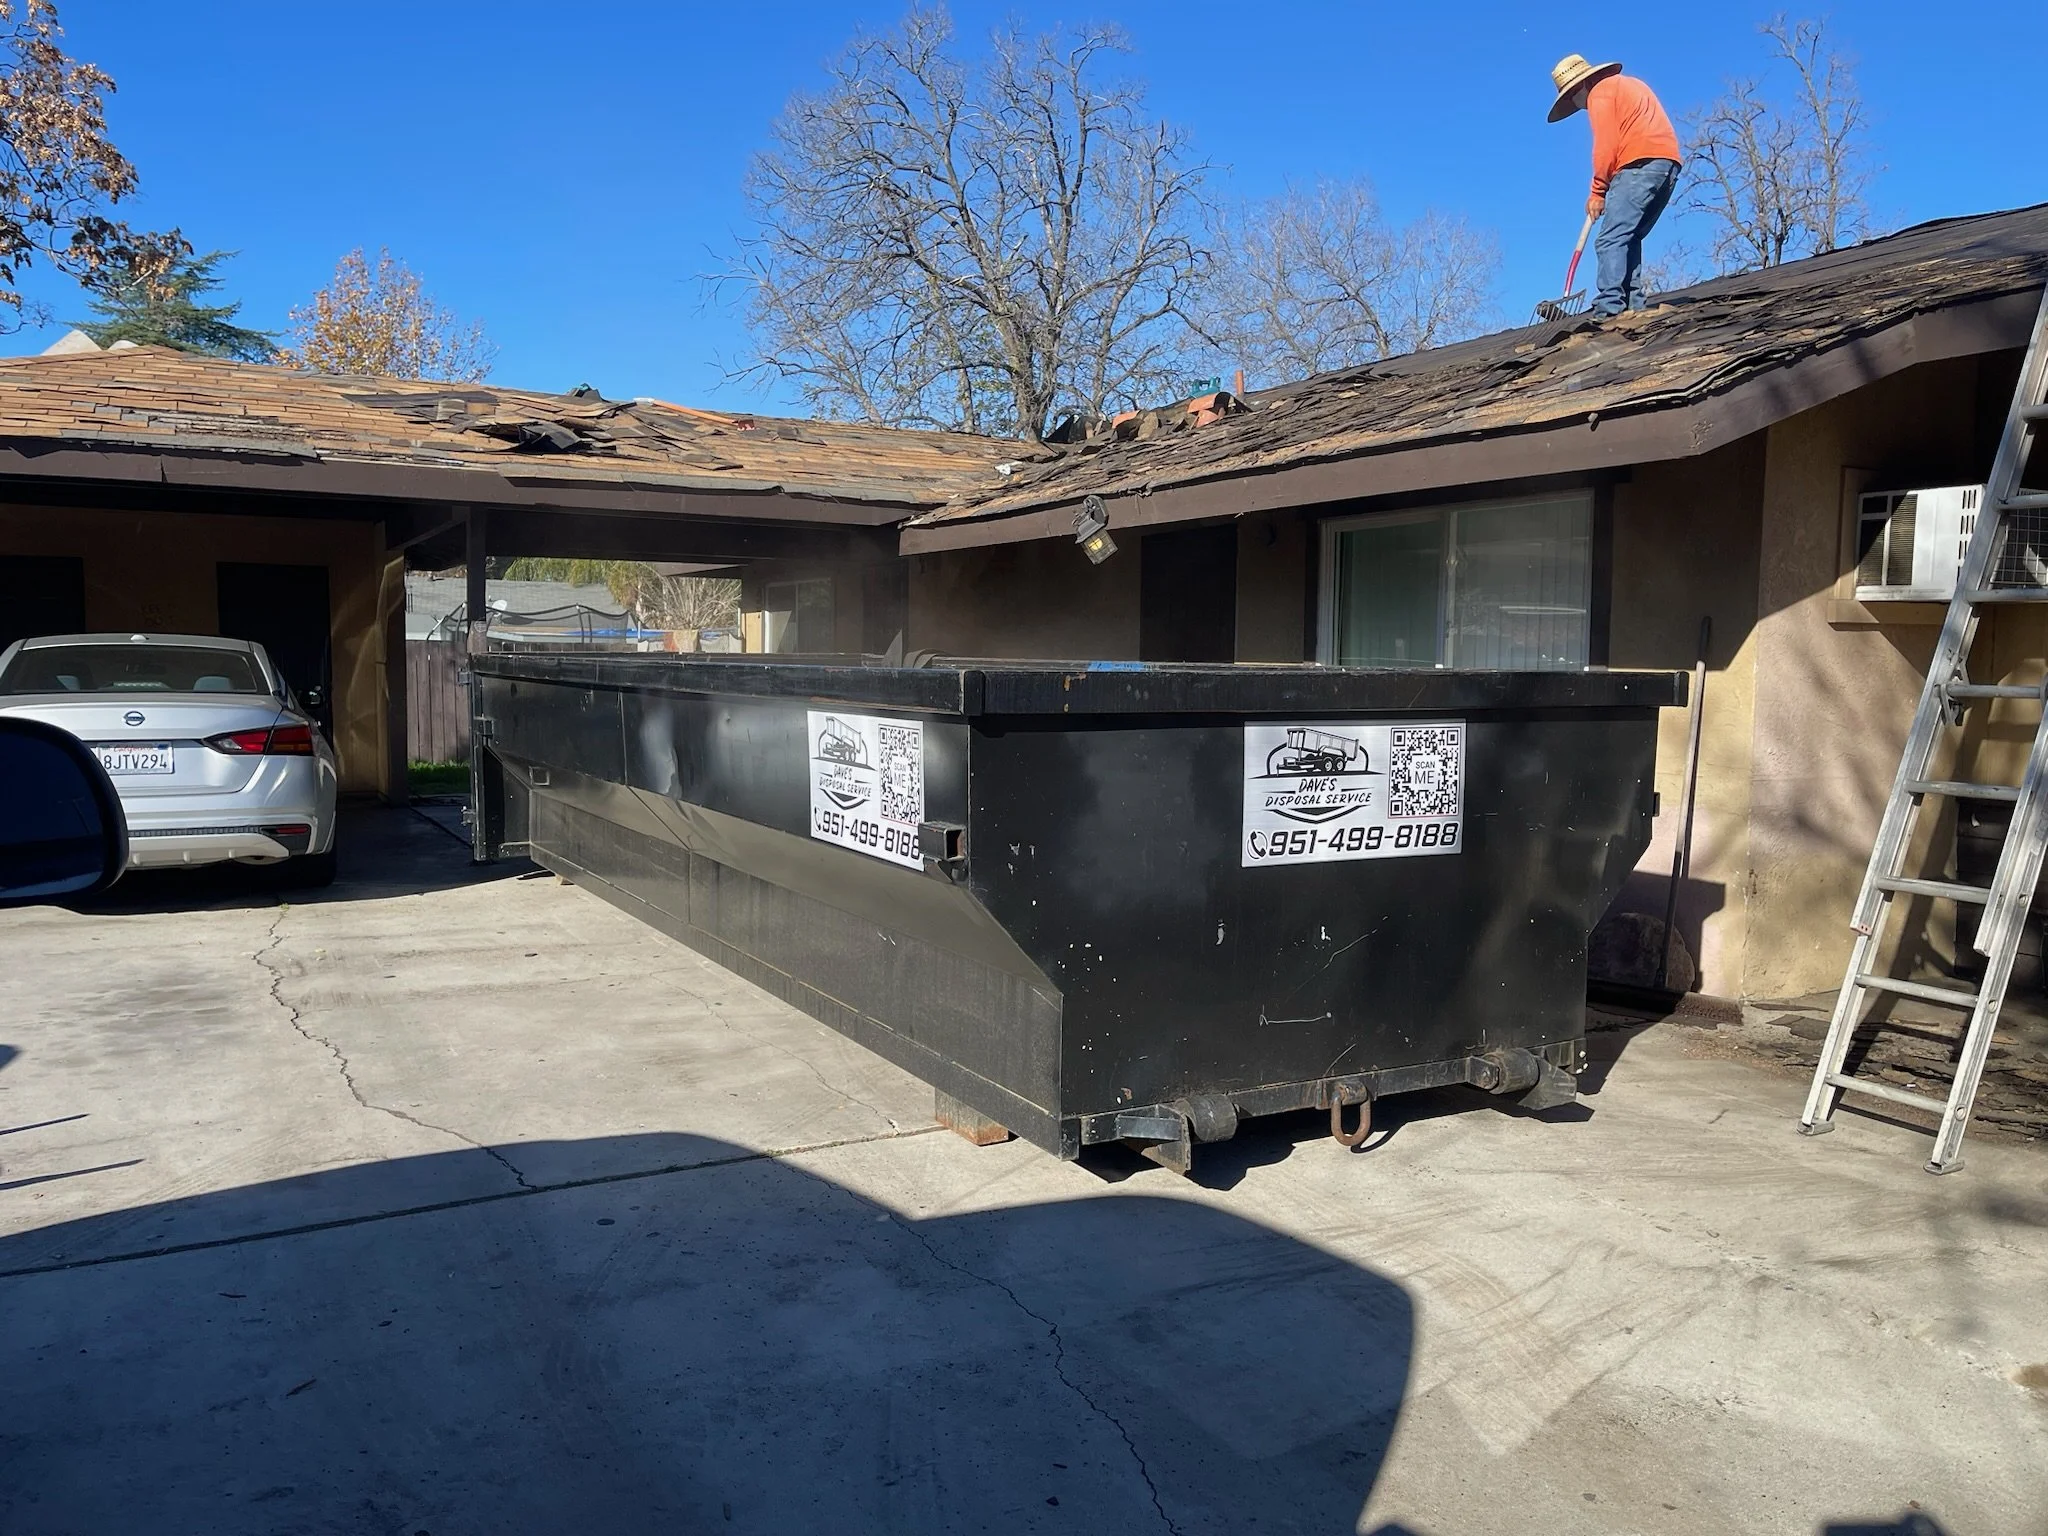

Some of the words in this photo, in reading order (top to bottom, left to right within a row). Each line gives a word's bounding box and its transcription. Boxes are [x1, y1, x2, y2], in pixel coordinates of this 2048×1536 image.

[104, 754, 167, 769] 8JTV294
[894, 762, 907, 772] SCAN
[1415, 761, 1436, 769] SCAN
[833, 764, 852, 781] DAVE'S
[1414, 770, 1435, 785] ME
[819, 776, 846, 794] DISPOSAL
[847, 782, 872, 798] SERVICE
[894, 773, 906, 789] ME
[1299, 776, 1338, 792] DAVE'S
[1265, 794, 1322, 807] DISPOSAL
[1325, 792, 1372, 804] SERVICE
[1269, 822, 1459, 857] 951-499-8188
